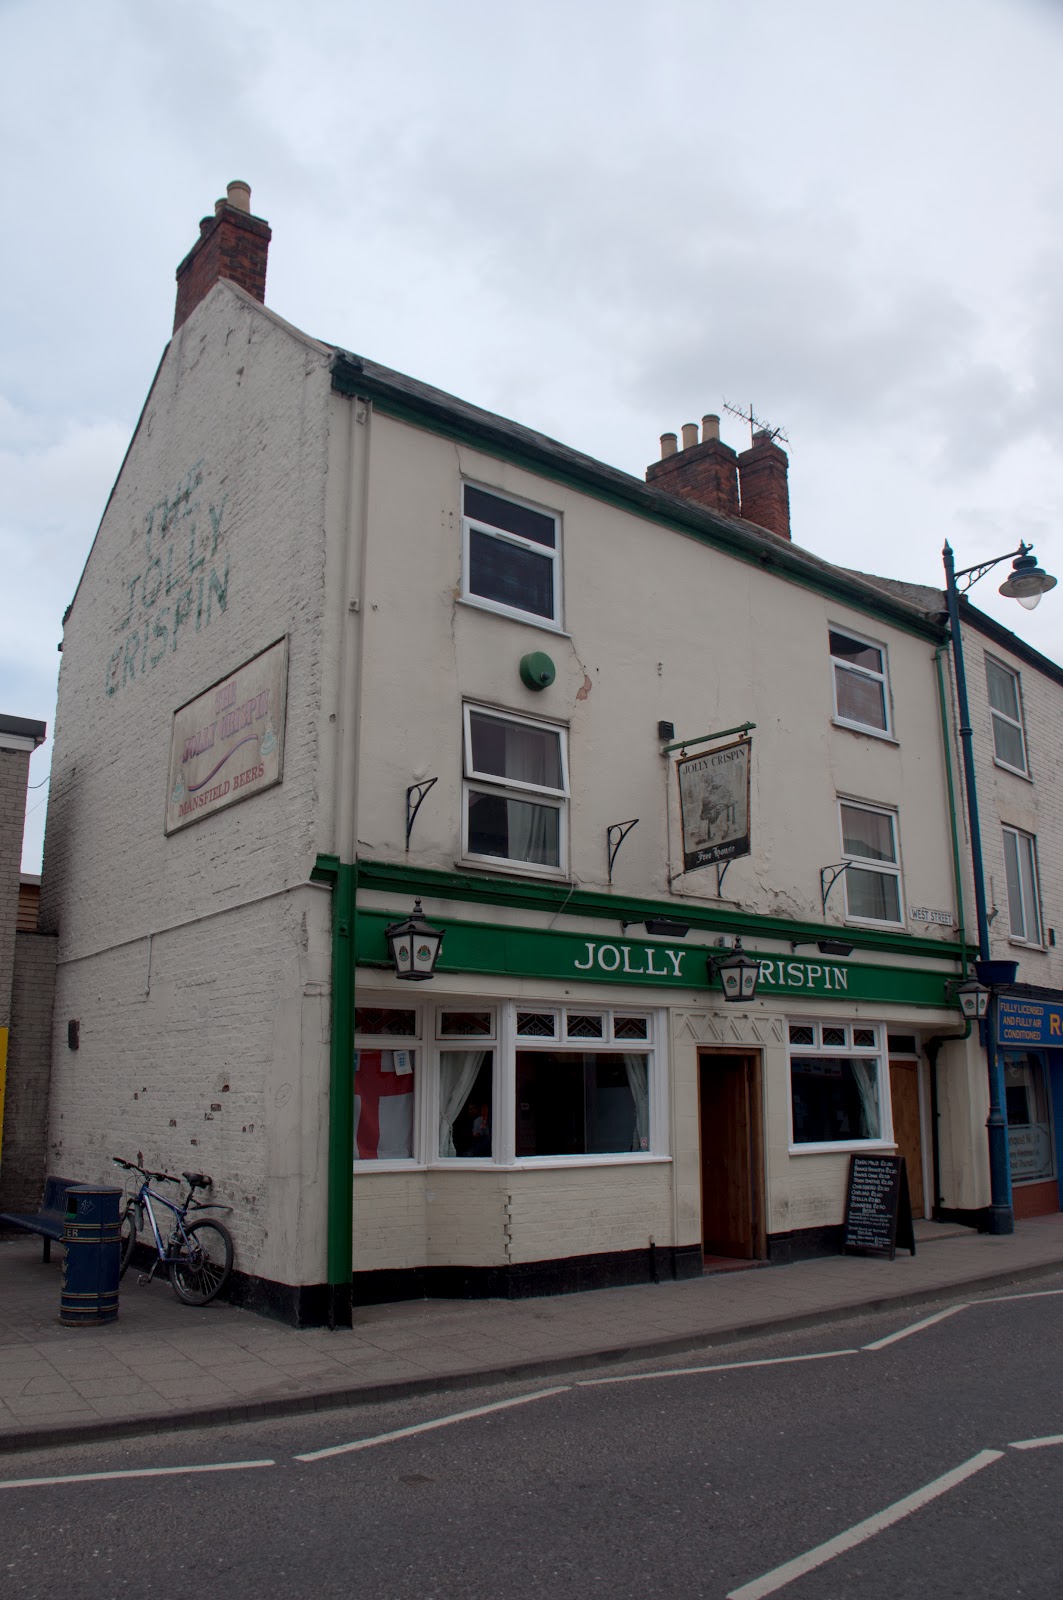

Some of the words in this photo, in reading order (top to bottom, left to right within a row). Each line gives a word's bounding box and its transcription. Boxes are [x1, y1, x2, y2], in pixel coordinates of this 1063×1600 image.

[114, 493, 228, 631] JOLLY
[105, 554, 230, 698] CRISPIN
[182, 722, 217, 763] JOLLY
[220, 688, 270, 740] CRISPIN
[682, 760, 709, 776] JOLLY
[711, 748, 746, 767] CRISPIN
[178, 780, 231, 817] MANSFIELD
[232, 762, 265, 791] BEERS
[911, 908, 930, 920] WEST
[930, 911, 952, 924] STREET
[574, 942, 686, 977] JOLLY
[753, 958, 848, 990] RISPIN
[1000, 1003, 1017, 1012] FULLY
[1018, 1005, 1044, 1015] LICENSED
[1003, 1016, 1015, 1025] AND
[1015, 1017, 1032, 1027] FULLY
[1033, 1019, 1042, 1028] AIR
[1004, 1029, 1041, 1040] CONDITIONED
